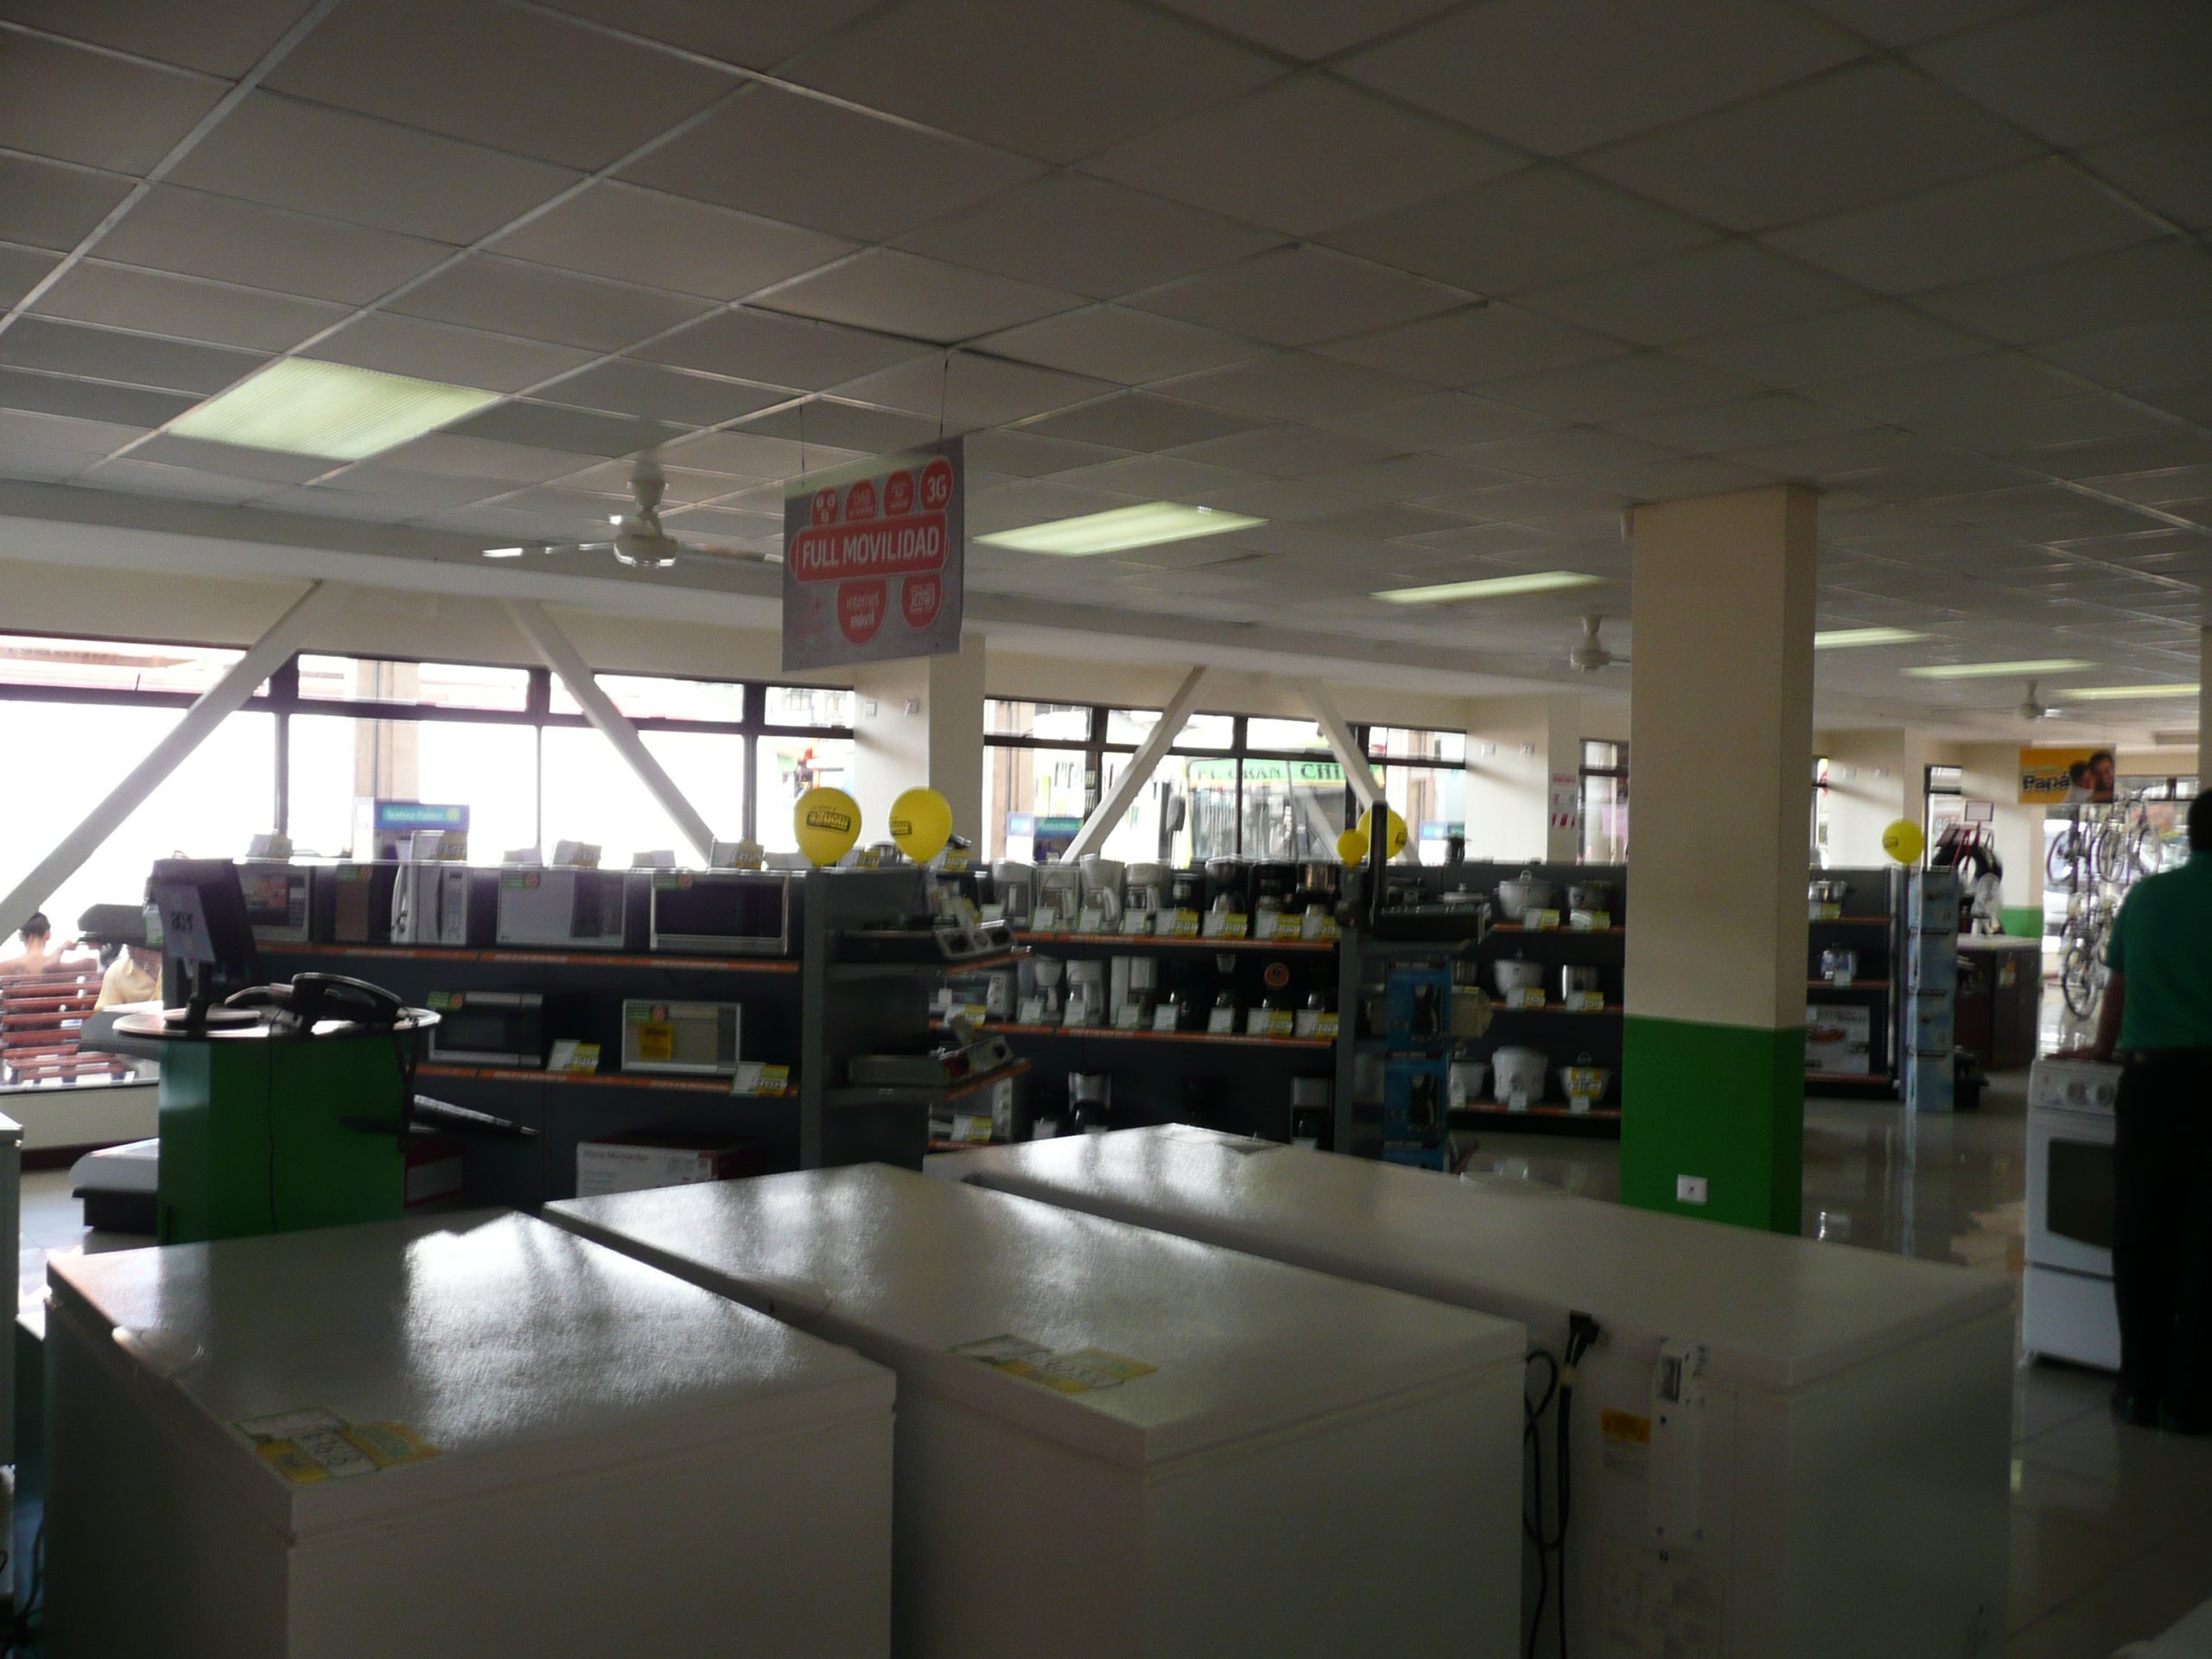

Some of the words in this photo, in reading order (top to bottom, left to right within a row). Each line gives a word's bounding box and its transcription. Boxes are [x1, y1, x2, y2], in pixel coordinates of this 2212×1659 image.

[927, 476, 947, 503] 3G
[802, 537, 840, 571] FULL
[842, 525, 939, 563] MOVILIDAD
[1300, 763, 1340, 780] CHI
